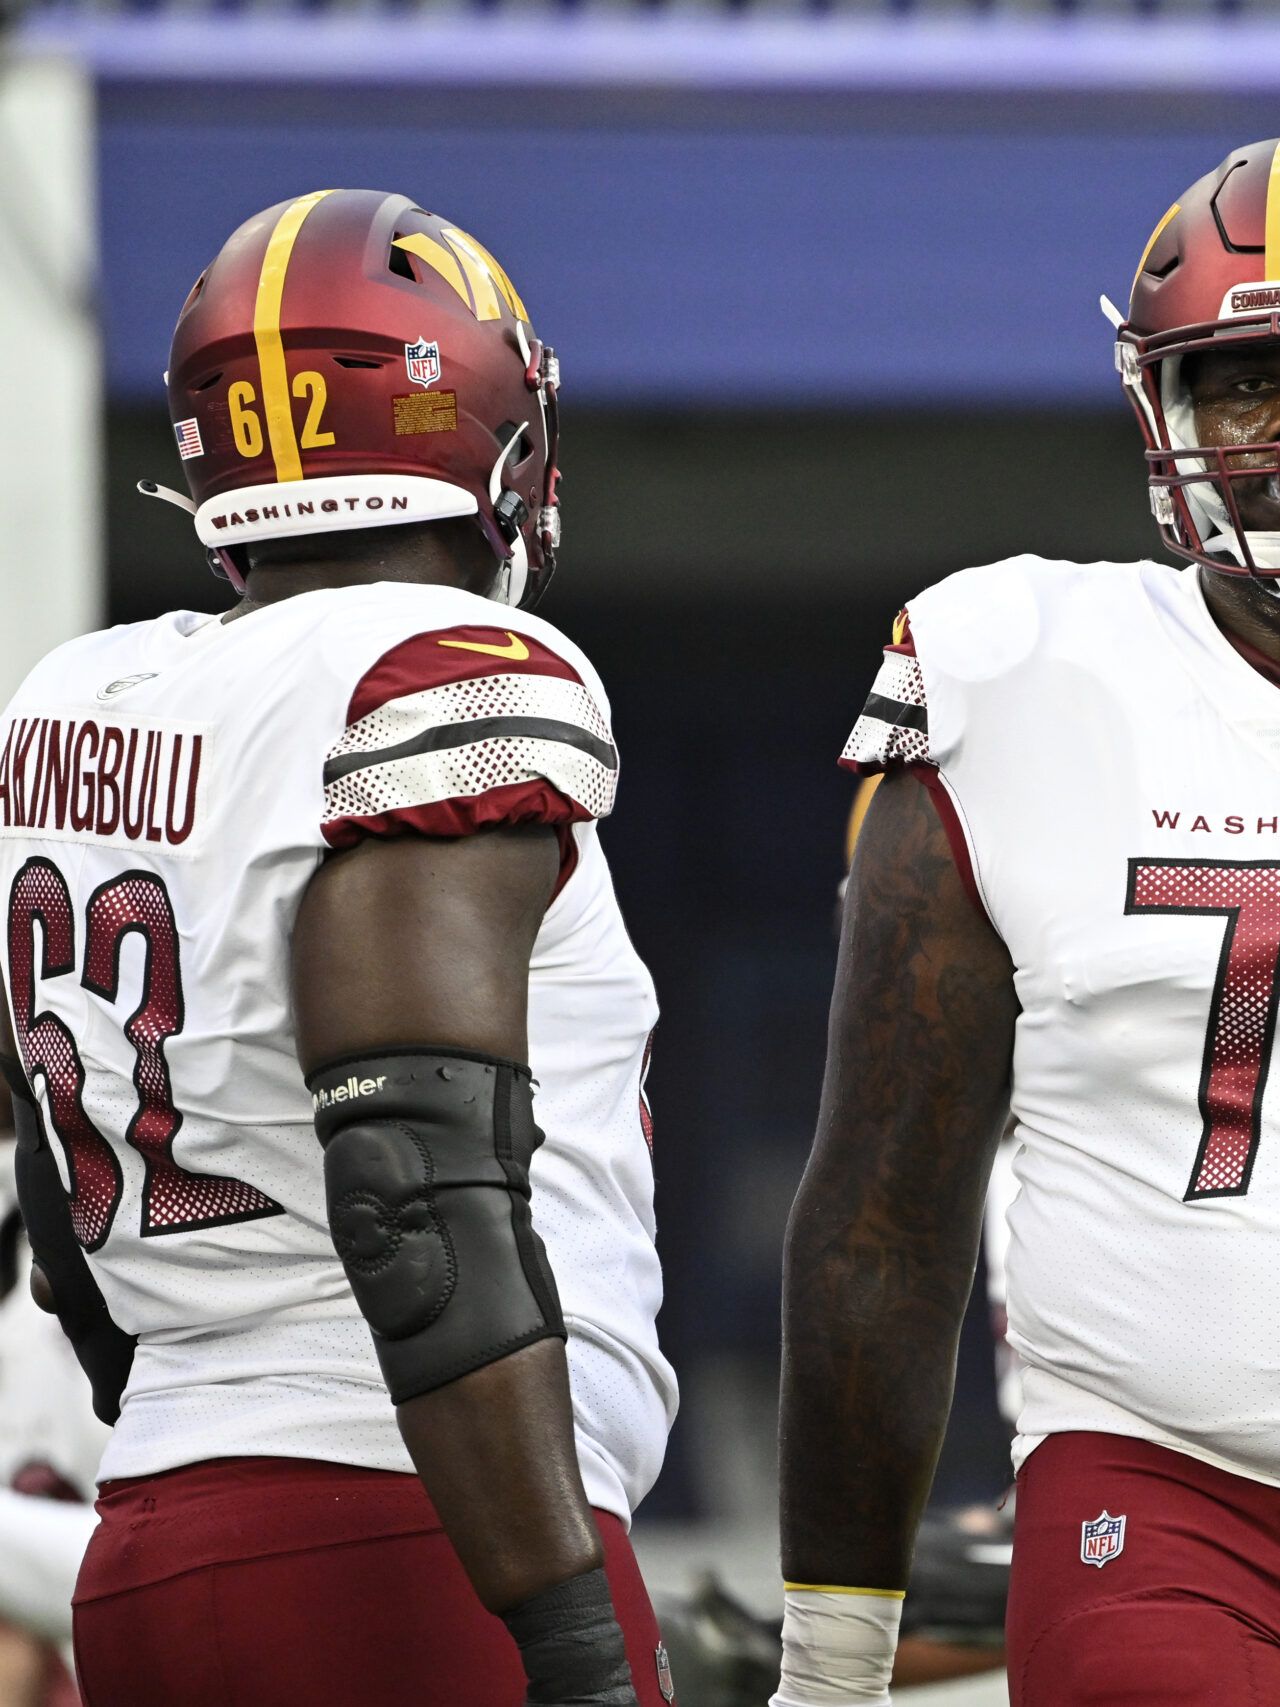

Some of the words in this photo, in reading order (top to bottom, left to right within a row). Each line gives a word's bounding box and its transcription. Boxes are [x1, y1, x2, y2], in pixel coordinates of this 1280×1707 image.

[411, 359, 437, 380] NFL
[211, 496, 408, 530] WASHINGTON
[0, 717, 203, 846] AKINGBULU
[7, 855, 287, 1254] 62
[1087, 1535, 1116, 1557] NFL
